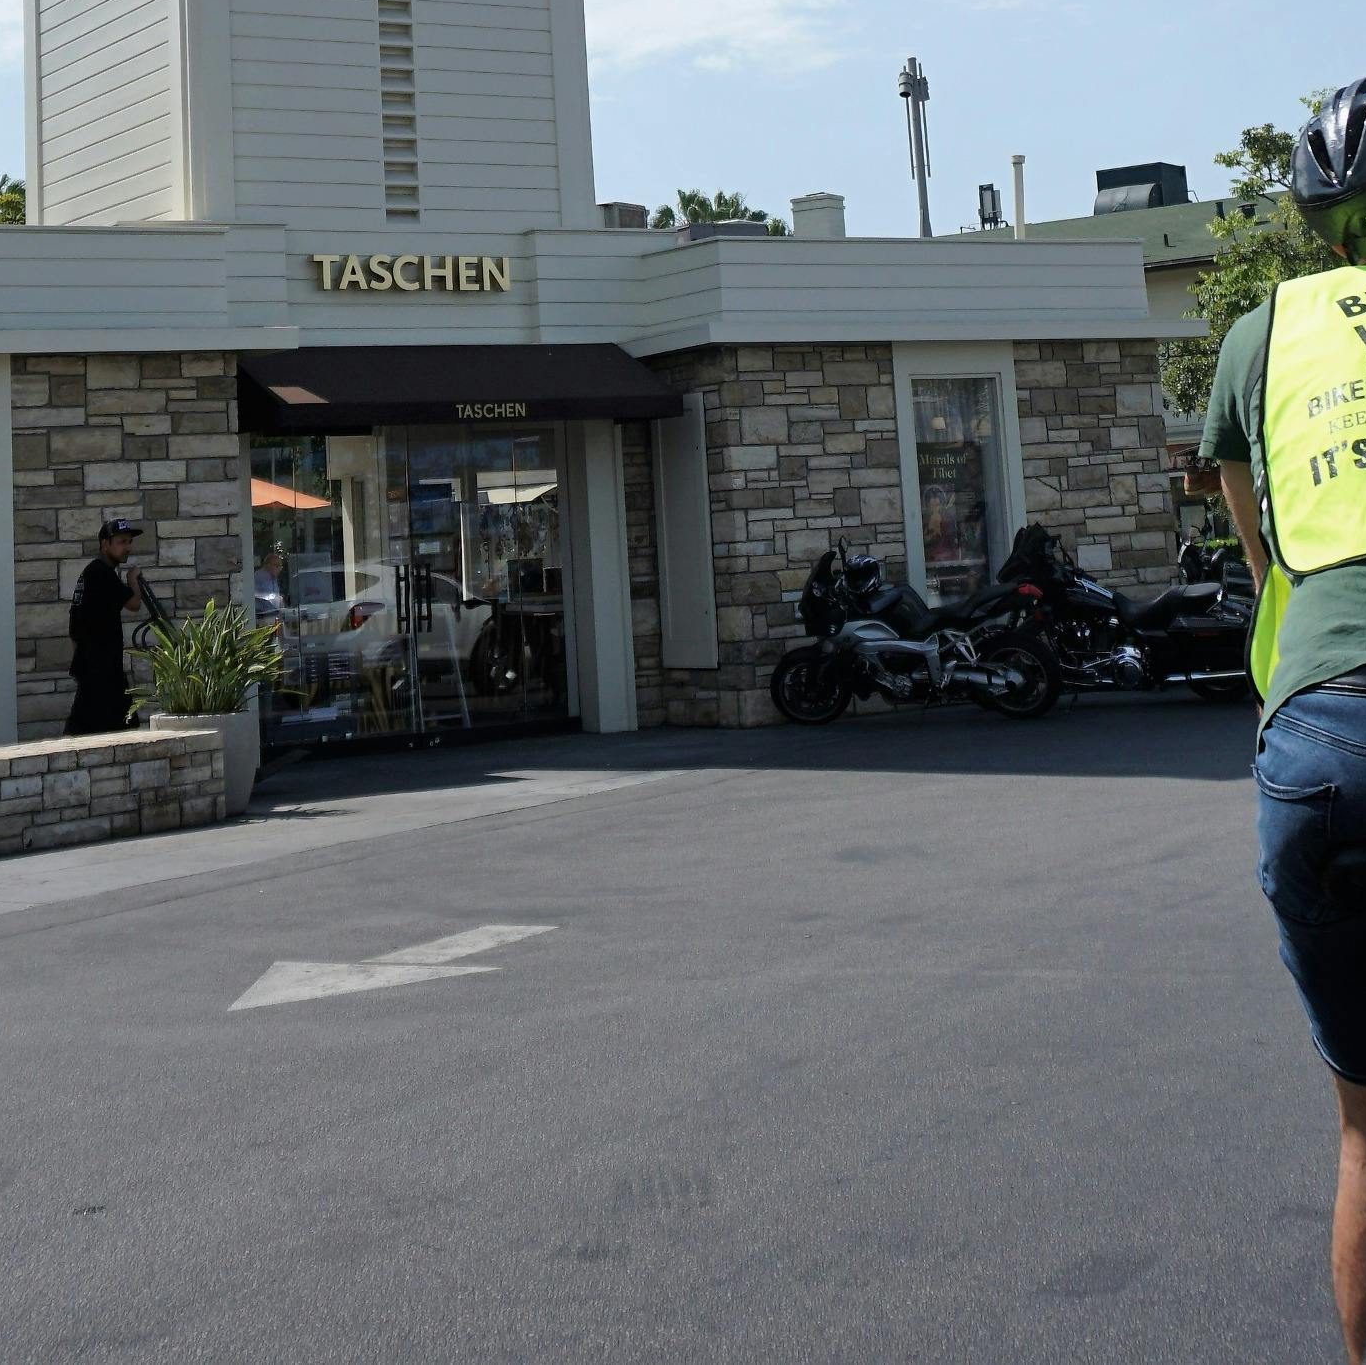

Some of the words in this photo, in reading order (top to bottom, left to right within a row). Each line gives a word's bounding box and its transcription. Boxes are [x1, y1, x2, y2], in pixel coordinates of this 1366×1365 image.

[312, 253, 511, 293] TASCHEN
[455, 402, 527, 419] TASCHEN
[919, 452, 955, 465] Murals
[931, 467, 956, 479] Tibet
